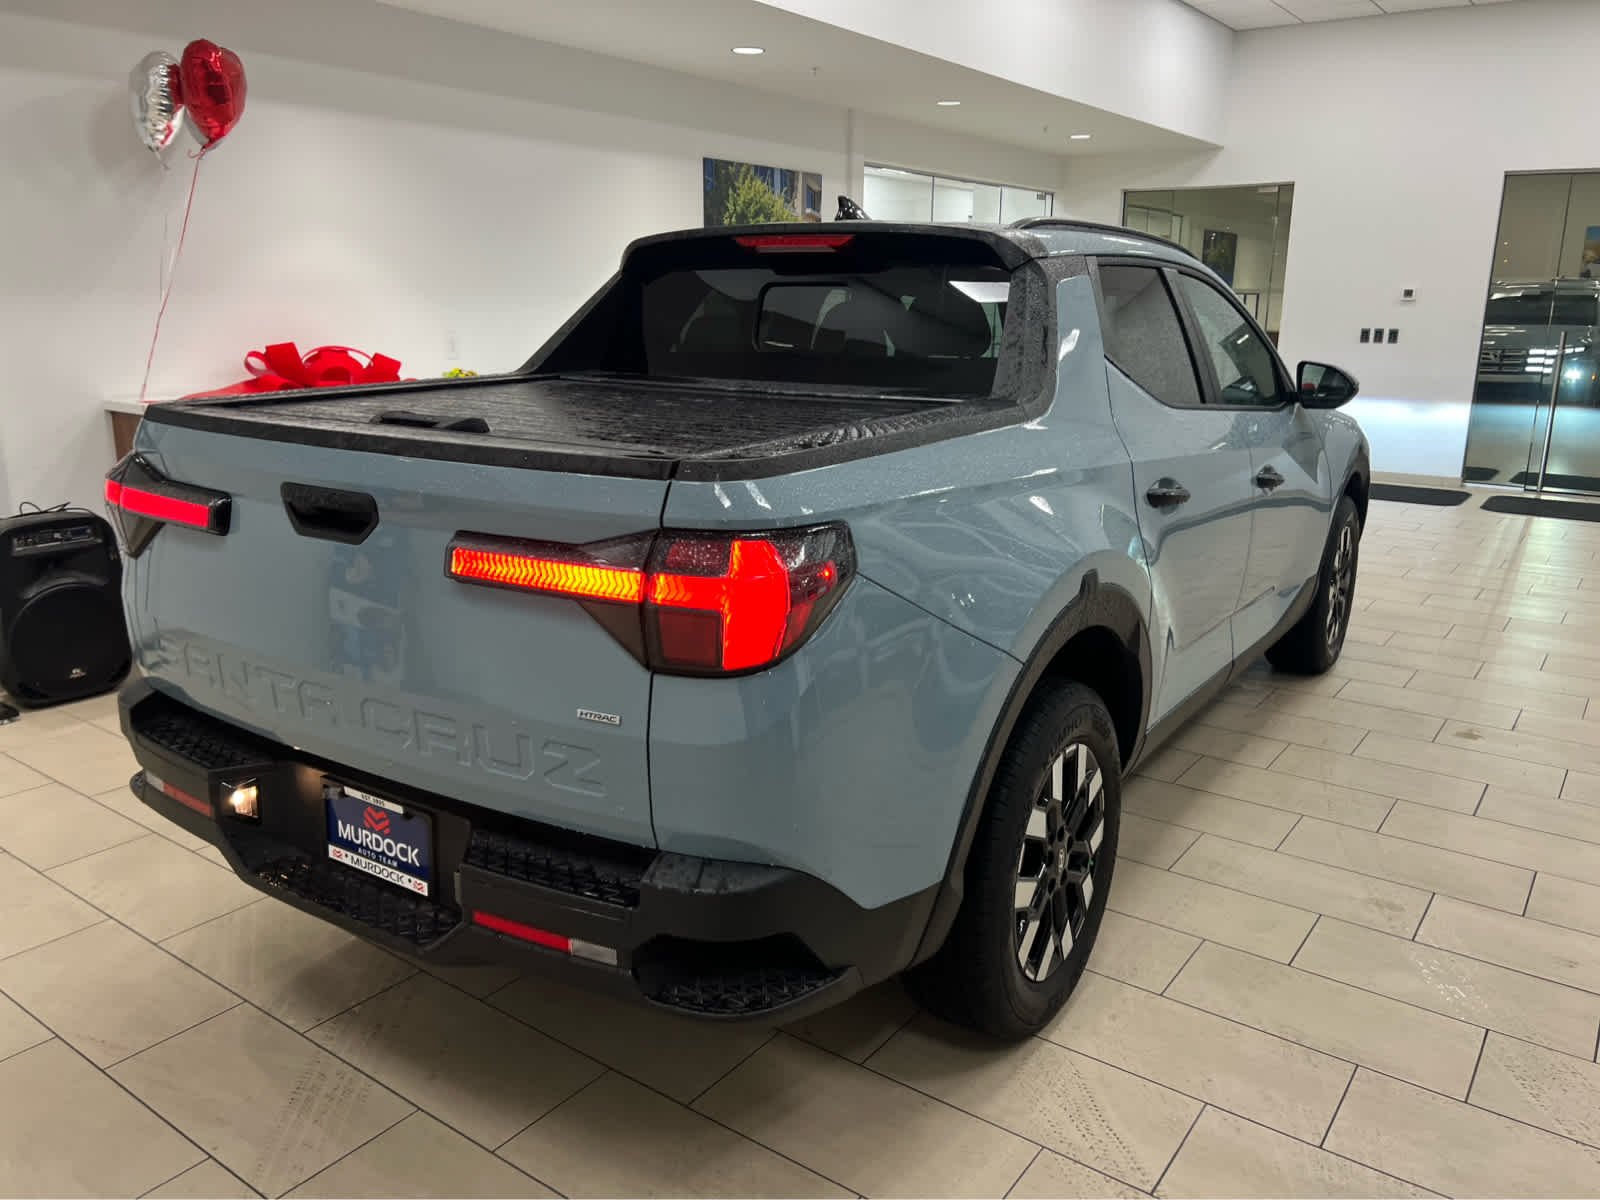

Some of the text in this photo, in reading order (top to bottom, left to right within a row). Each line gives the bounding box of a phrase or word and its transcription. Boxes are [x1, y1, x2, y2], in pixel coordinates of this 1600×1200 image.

[579, 711, 617, 723] HTRAC
[360, 697, 609, 799] CRUZ
[338, 820, 420, 867] MURDOCK
[358, 847, 398, 868] AUTO TEAM
[350, 855, 405, 885] MURDOCK
